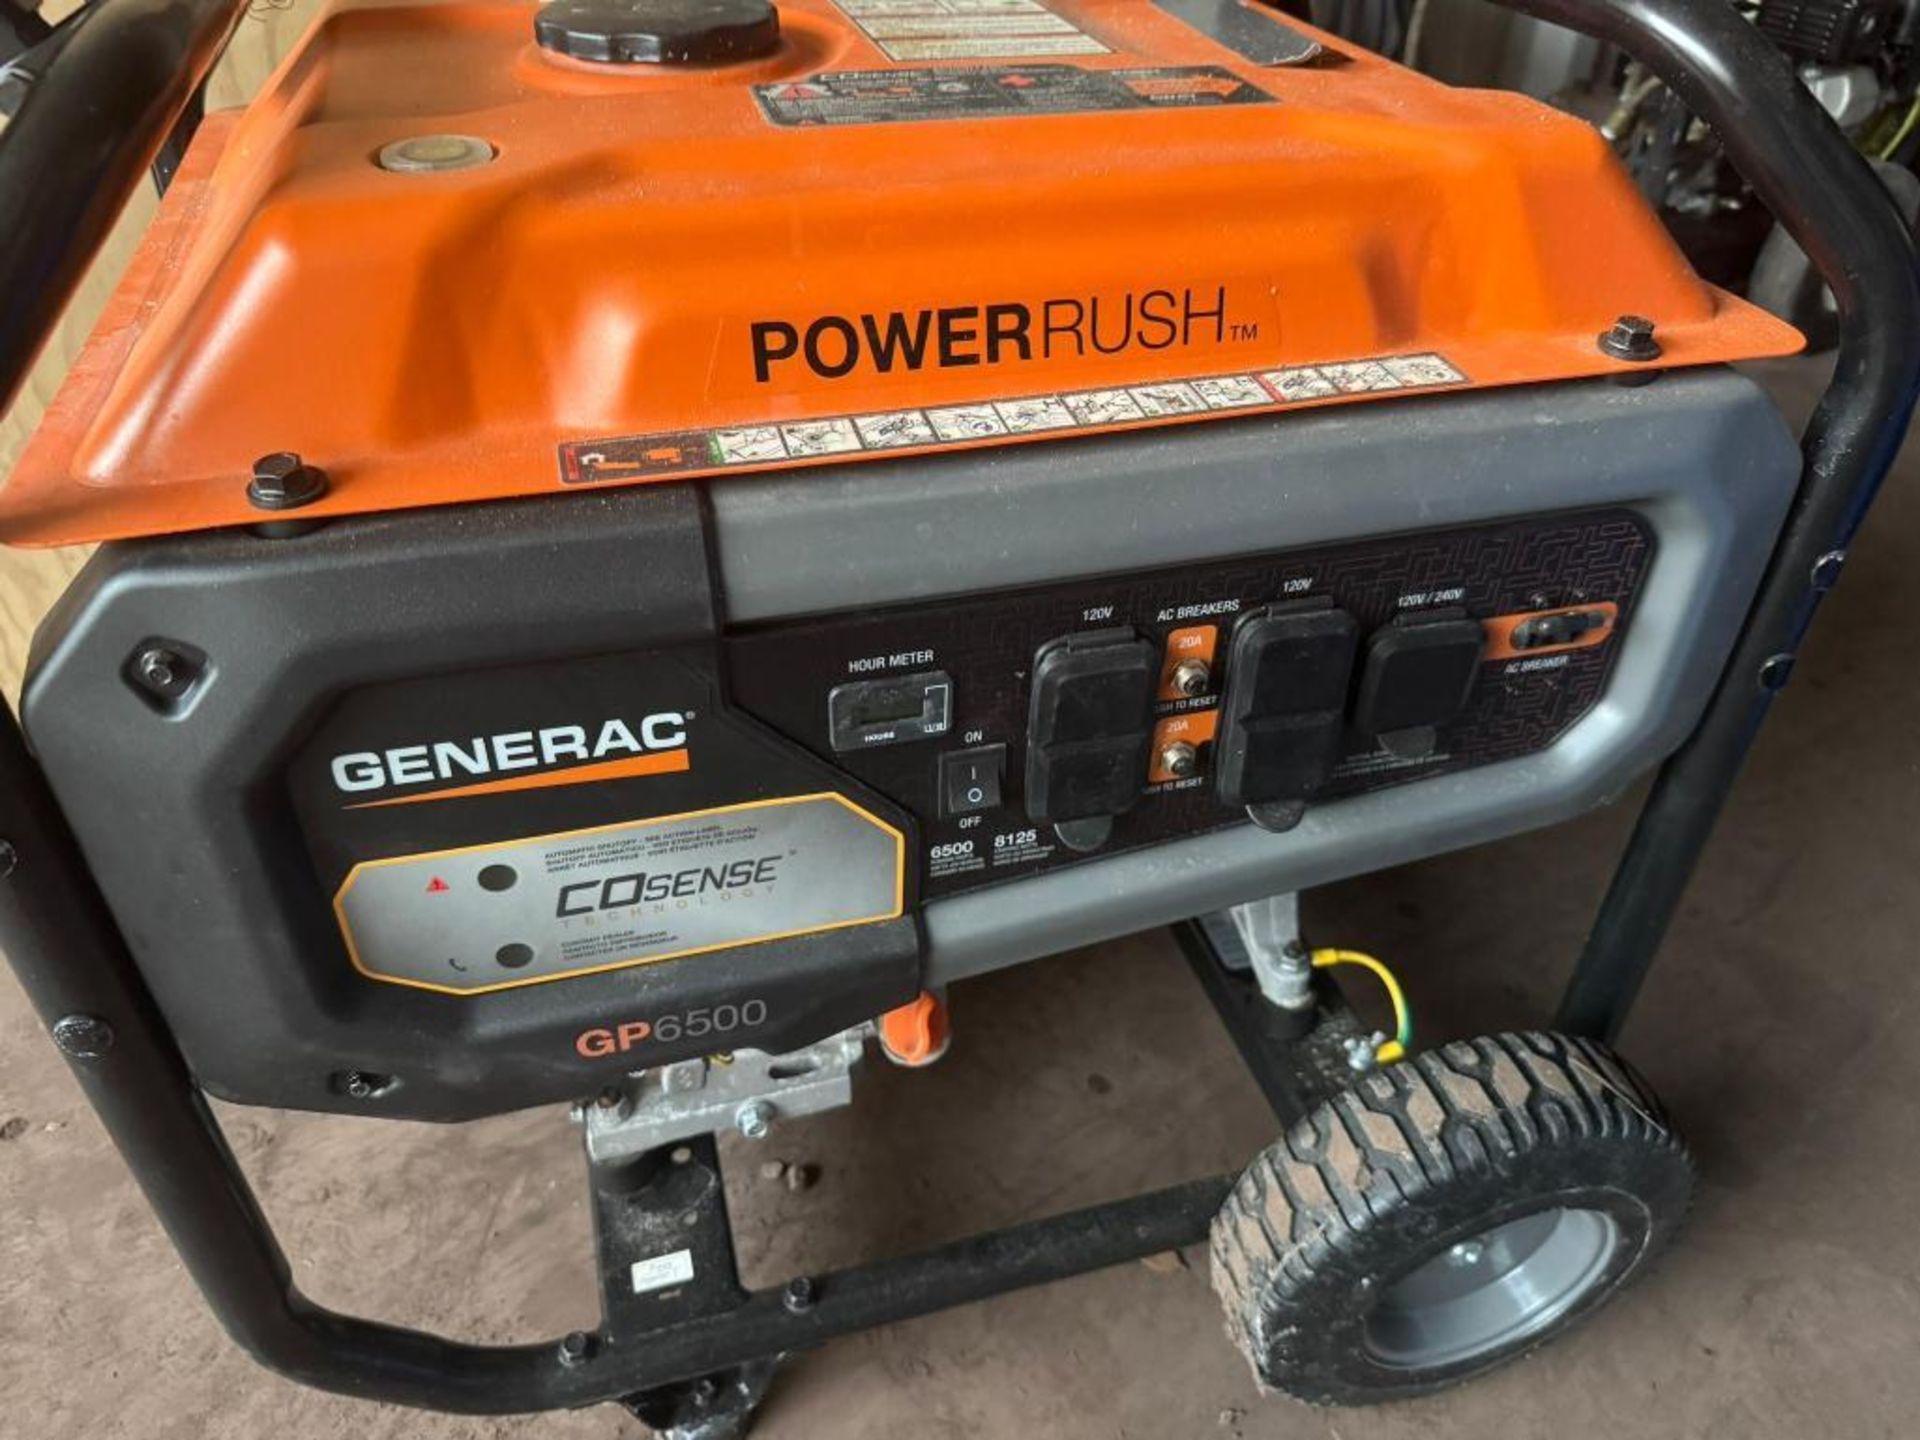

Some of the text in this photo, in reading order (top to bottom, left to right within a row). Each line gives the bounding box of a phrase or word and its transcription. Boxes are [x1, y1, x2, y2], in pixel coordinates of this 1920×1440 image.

[1284, 578, 1312, 592] 120V
[1083, 606, 1114, 622] 120V
[1157, 599, 1240, 622] AC BREAKERS
[849, 649, 934, 673] HOUR METER
[964, 731, 983, 744] ON
[959, 816, 982, 829] OFF
[994, 829, 1037, 848] 8125
[930, 840, 974, 859] 6500
[576, 999, 768, 1058] GP6500
